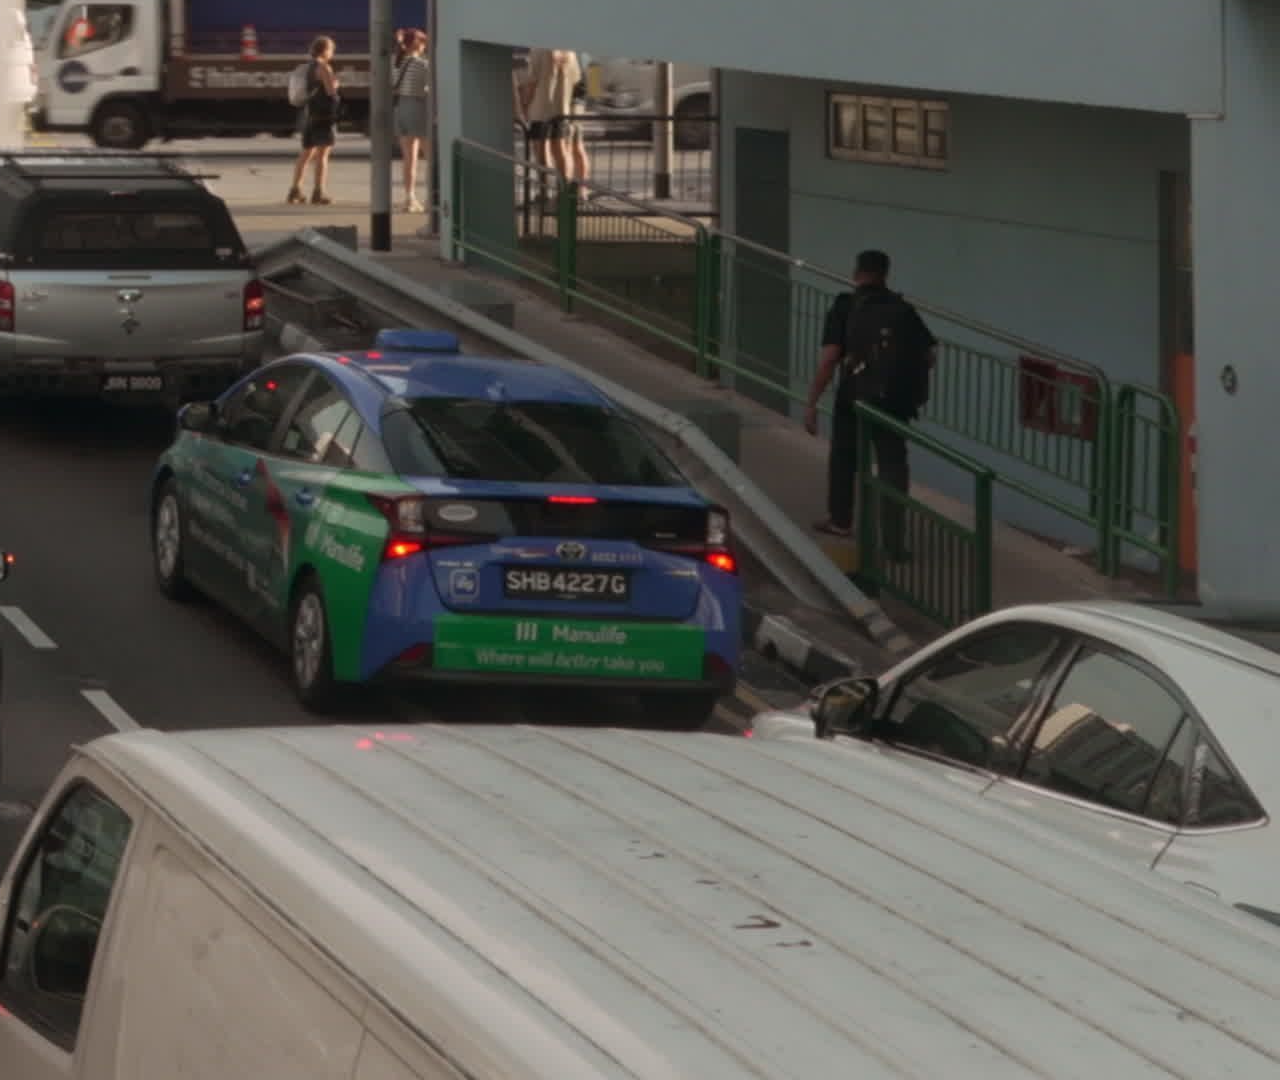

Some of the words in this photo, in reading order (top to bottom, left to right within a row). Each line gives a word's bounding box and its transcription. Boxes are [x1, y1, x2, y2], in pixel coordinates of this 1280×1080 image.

[505, 570, 627, 595] SHB4227G
[552, 624, 627, 645] Manulife
[476, 648, 526, 667] Where
[638, 659, 665, 675] you
